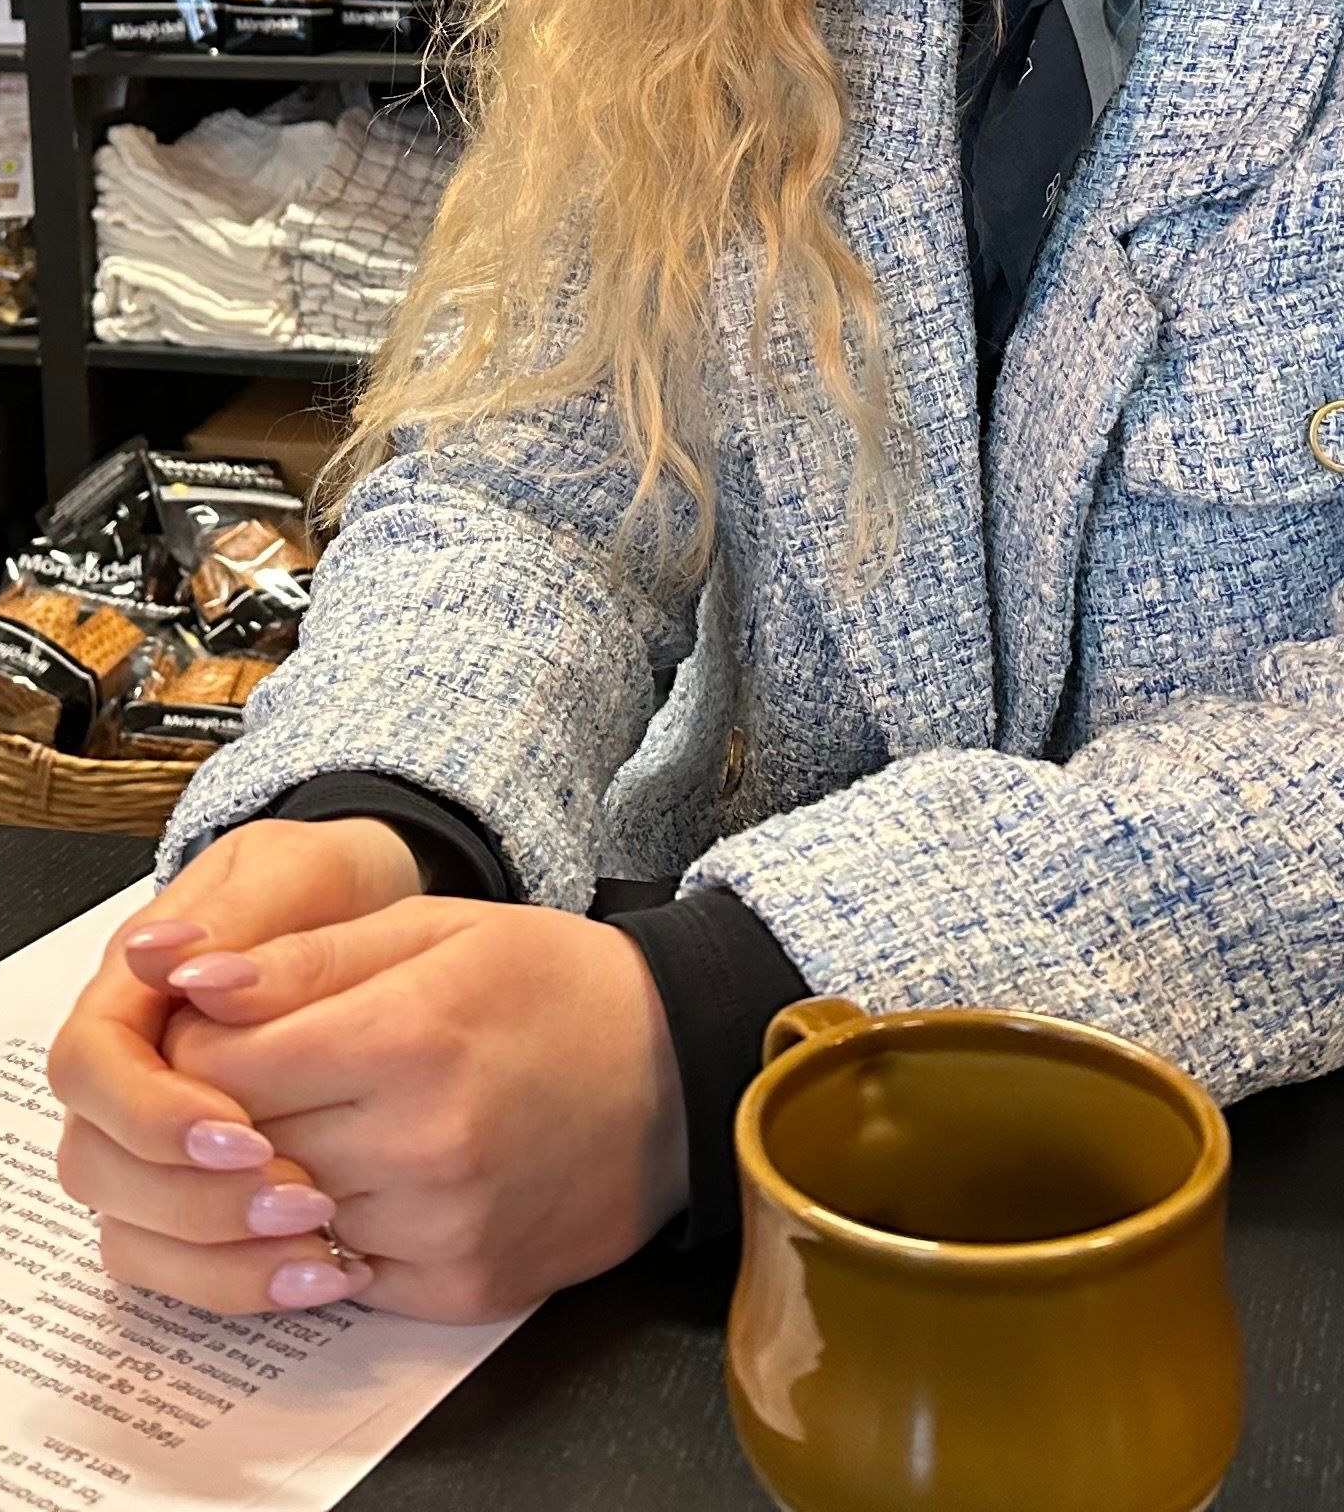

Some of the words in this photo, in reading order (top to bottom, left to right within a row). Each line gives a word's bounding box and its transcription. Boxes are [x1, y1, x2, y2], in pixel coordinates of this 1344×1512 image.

[6, 1037, 26, 1047] til
[2, 1052, 35, 1070] bety
[21, 1189, 55, 1204] mer
[10, 1207, 85, 1241] milliarder
[20, 1234, 65, 1257] hvert
[13, 1256, 46, 1274] Det
[71, 1256, 105, 1274] eies
[41, 1270, 120, 1305] egentlig?
[19, 1313, 48, 1329] for
[115, 1300, 208, 1343] problemet
[220, 1320, 251, 1336] eie
[273, 1317, 322, 1342] 2023
[5, 1332, 43, 1351] som
[45, 1323, 121, 1360] ansvaret
[118, 1328, 169, 1354] menn
[263, 1339, 307, 1361] uten
[41, 1349, 111, 1384] andelen
[115, 1355, 165, 1381] Også
[224, 1348, 260, 1369] hva
[190, 1362, 260, 1396] kvinner
[72, 1390, 134, 1422] mange
[131, 1418, 185, 1448] Ifølge
[1, 1451, 28, 1467] til
[84, 1458, 131, 1484] vært
[25, 1461, 75, 1489] store
[71, 1485, 103, 1505] for
